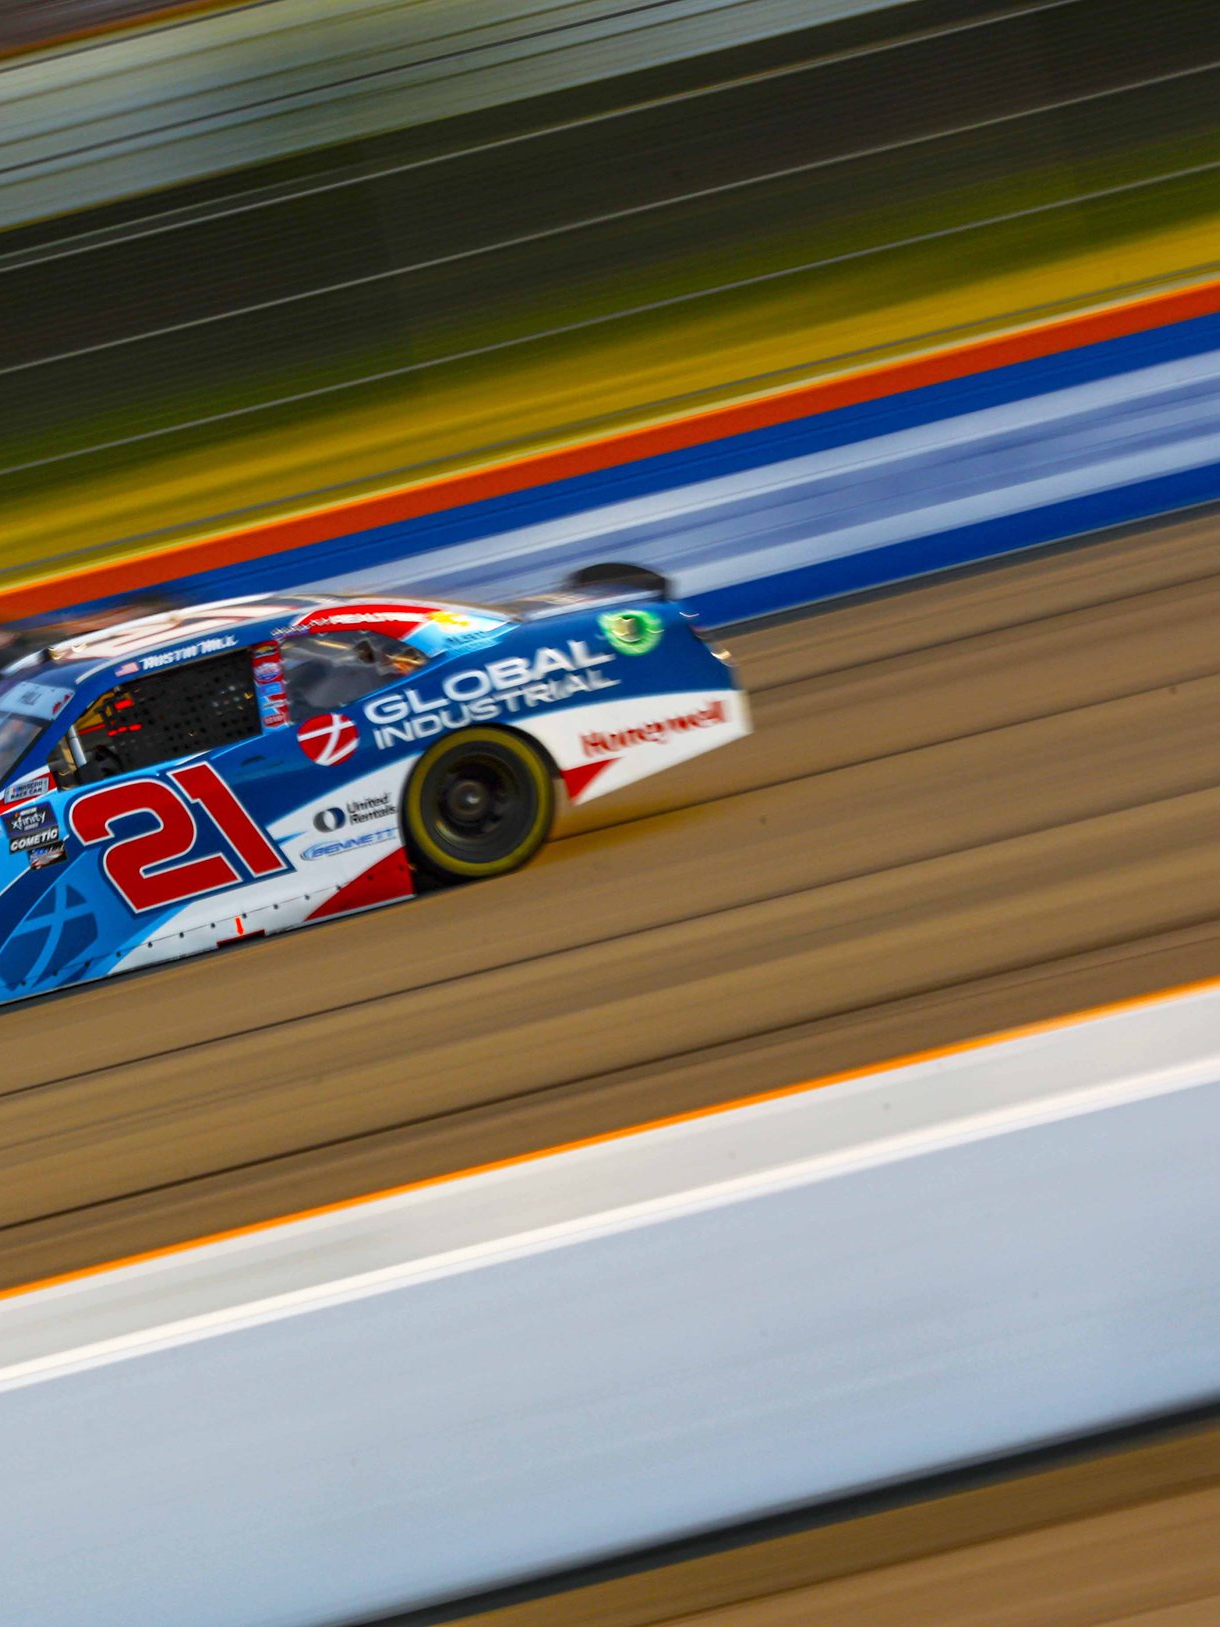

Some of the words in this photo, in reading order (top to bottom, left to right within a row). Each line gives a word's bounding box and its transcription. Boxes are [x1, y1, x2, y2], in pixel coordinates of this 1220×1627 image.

[363, 639, 616, 725] GLOBAL
[372, 668, 621, 750] INDUSTRIAL
[580, 700, 726, 757] Honeywell
[346, 792, 391, 813] United
[349, 804, 397, 825] Rentals
[11, 810, 46, 831] xfinity
[10, 828, 58, 851] COMETIC
[69, 761, 288, 914] 21
[311, 827, 398, 858] BENNETT
